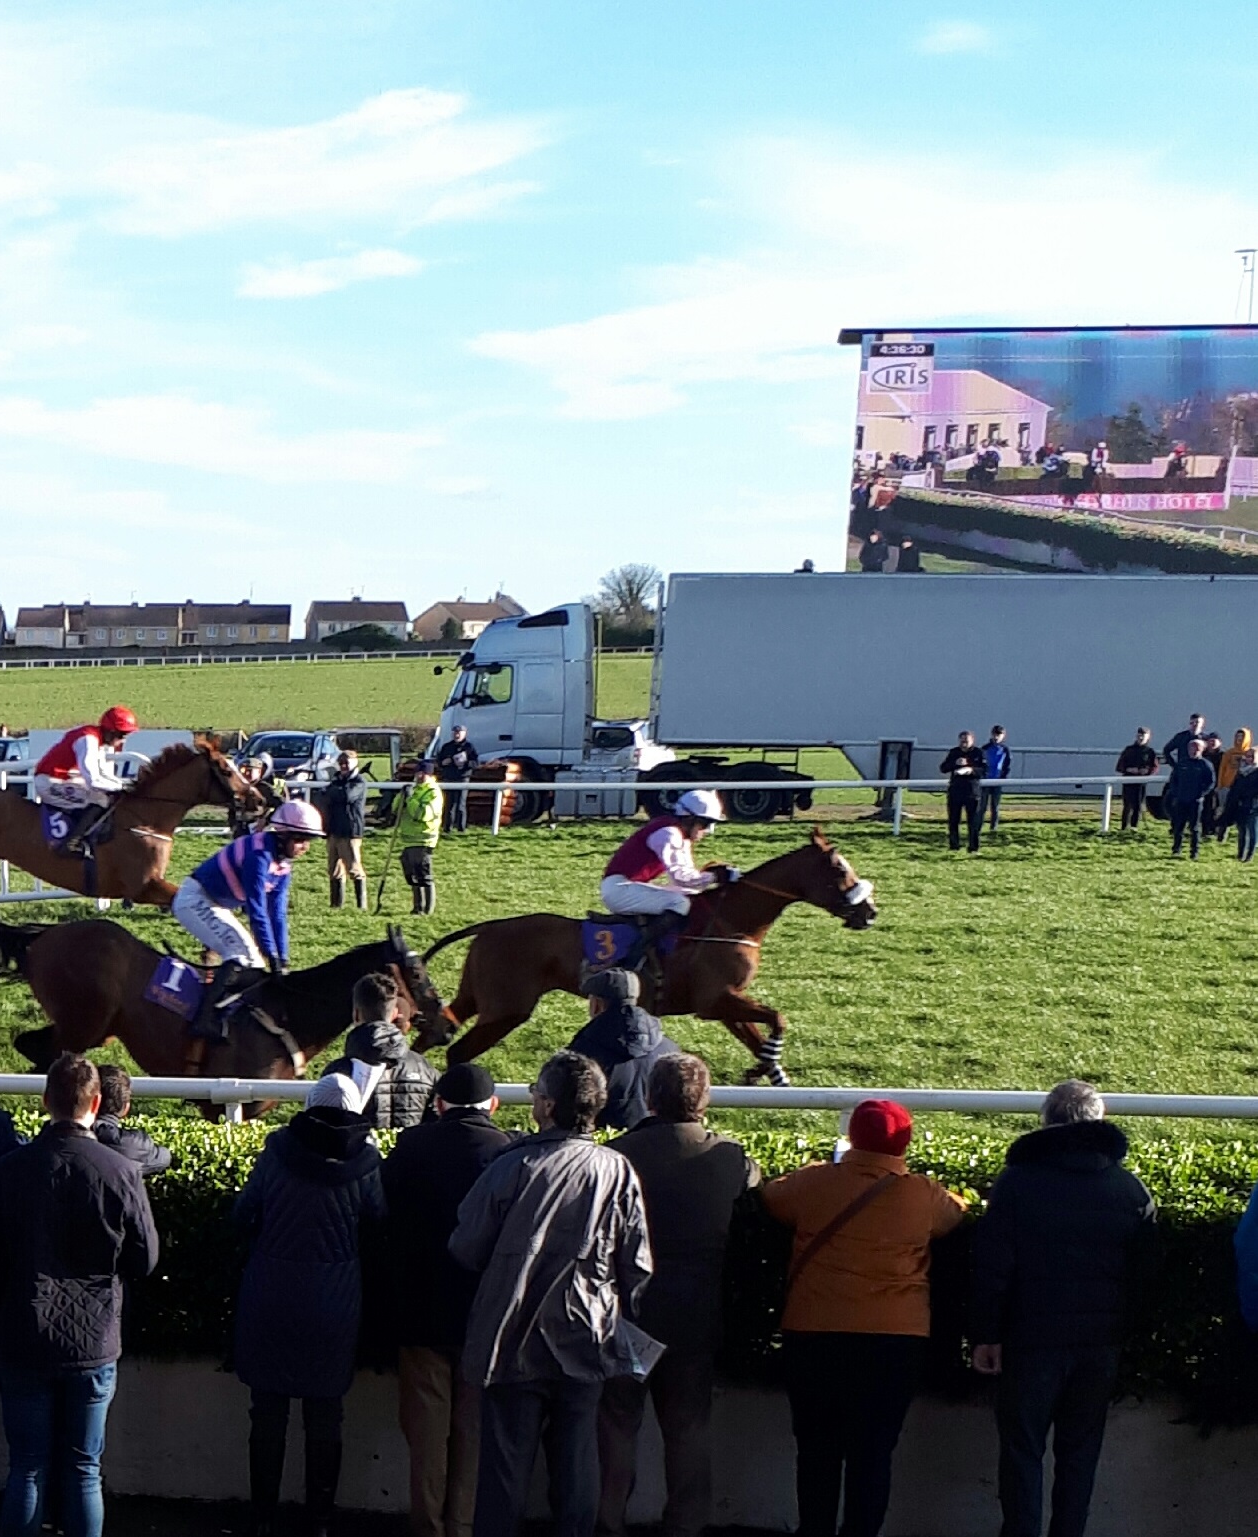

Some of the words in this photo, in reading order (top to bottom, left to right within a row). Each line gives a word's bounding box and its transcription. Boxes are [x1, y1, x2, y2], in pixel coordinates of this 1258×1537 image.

[49, 811, 69, 838] 5
[594, 930, 617, 960] 3
[161, 961, 186, 992] 1
